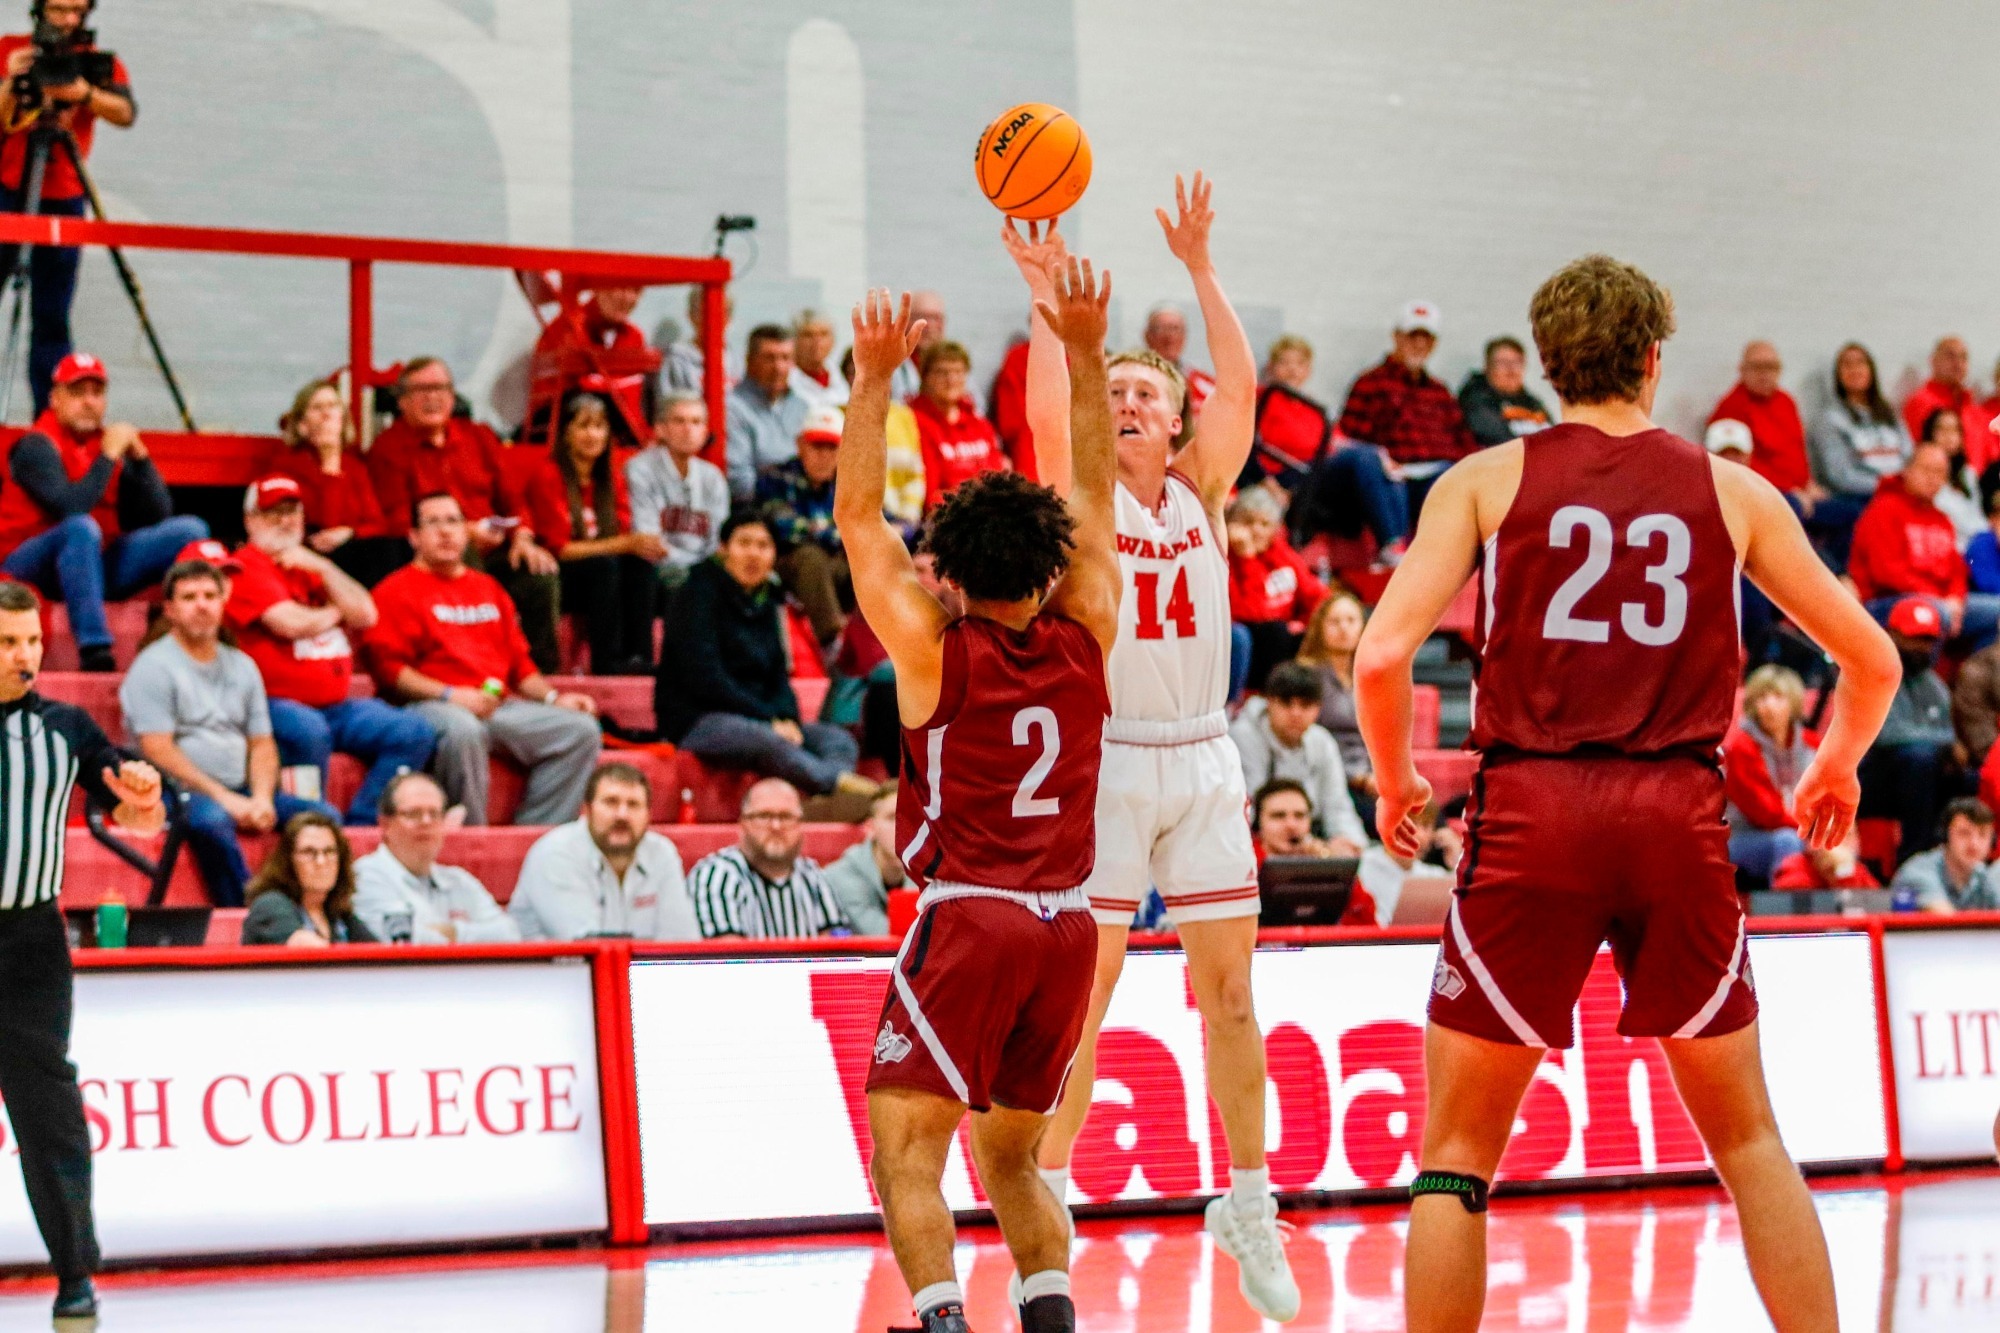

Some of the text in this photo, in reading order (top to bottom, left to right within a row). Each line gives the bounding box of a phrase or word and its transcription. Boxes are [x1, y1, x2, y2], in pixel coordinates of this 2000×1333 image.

[993, 112, 1034, 158] NCAA
[1116, 527, 1204, 560] WABH
[1543, 505, 1691, 646] 23
[1134, 565, 1197, 640] 14
[1012, 706, 1061, 818] 2
[1910, 1010, 2000, 1080] LIT
[0, 1065, 583, 1156] SH COLLEGE
